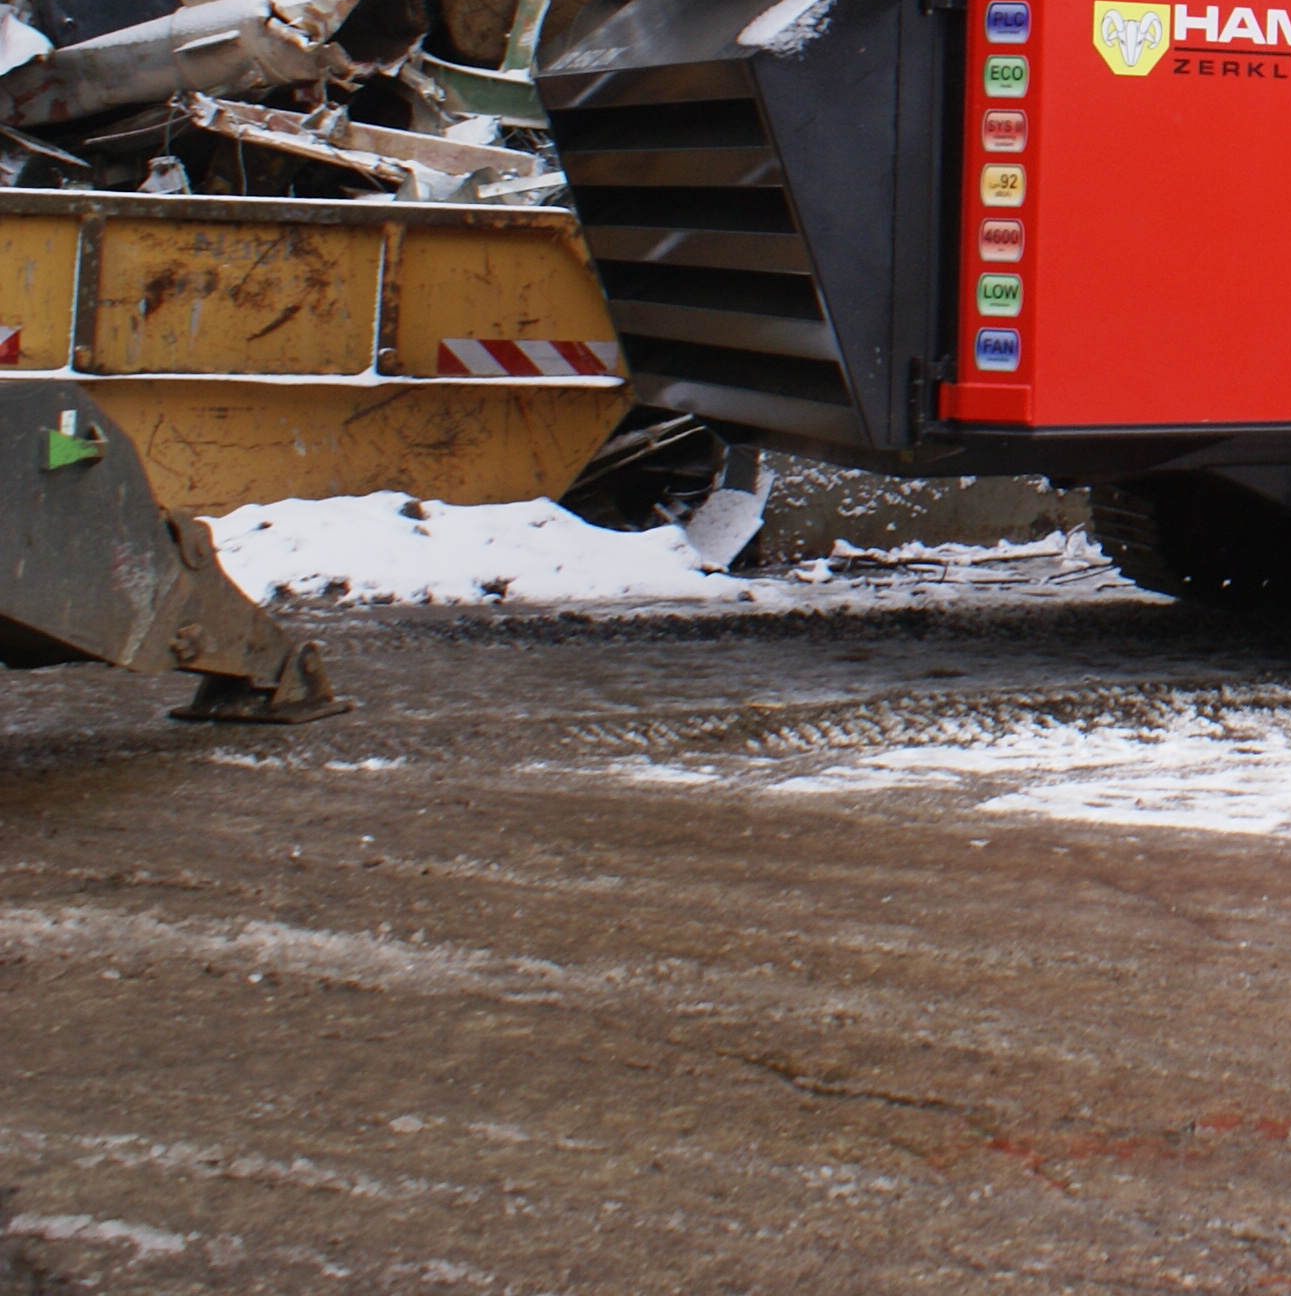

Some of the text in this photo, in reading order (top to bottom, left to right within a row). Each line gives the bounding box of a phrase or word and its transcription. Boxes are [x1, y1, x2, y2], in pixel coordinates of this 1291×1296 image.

[993, 11, 1025, 27] PLC
[989, 65, 1024, 81] ECO
[983, 228, 1019, 245] 4600
[983, 283, 1019, 300] LOW
[983, 337, 1015, 354] FAN
